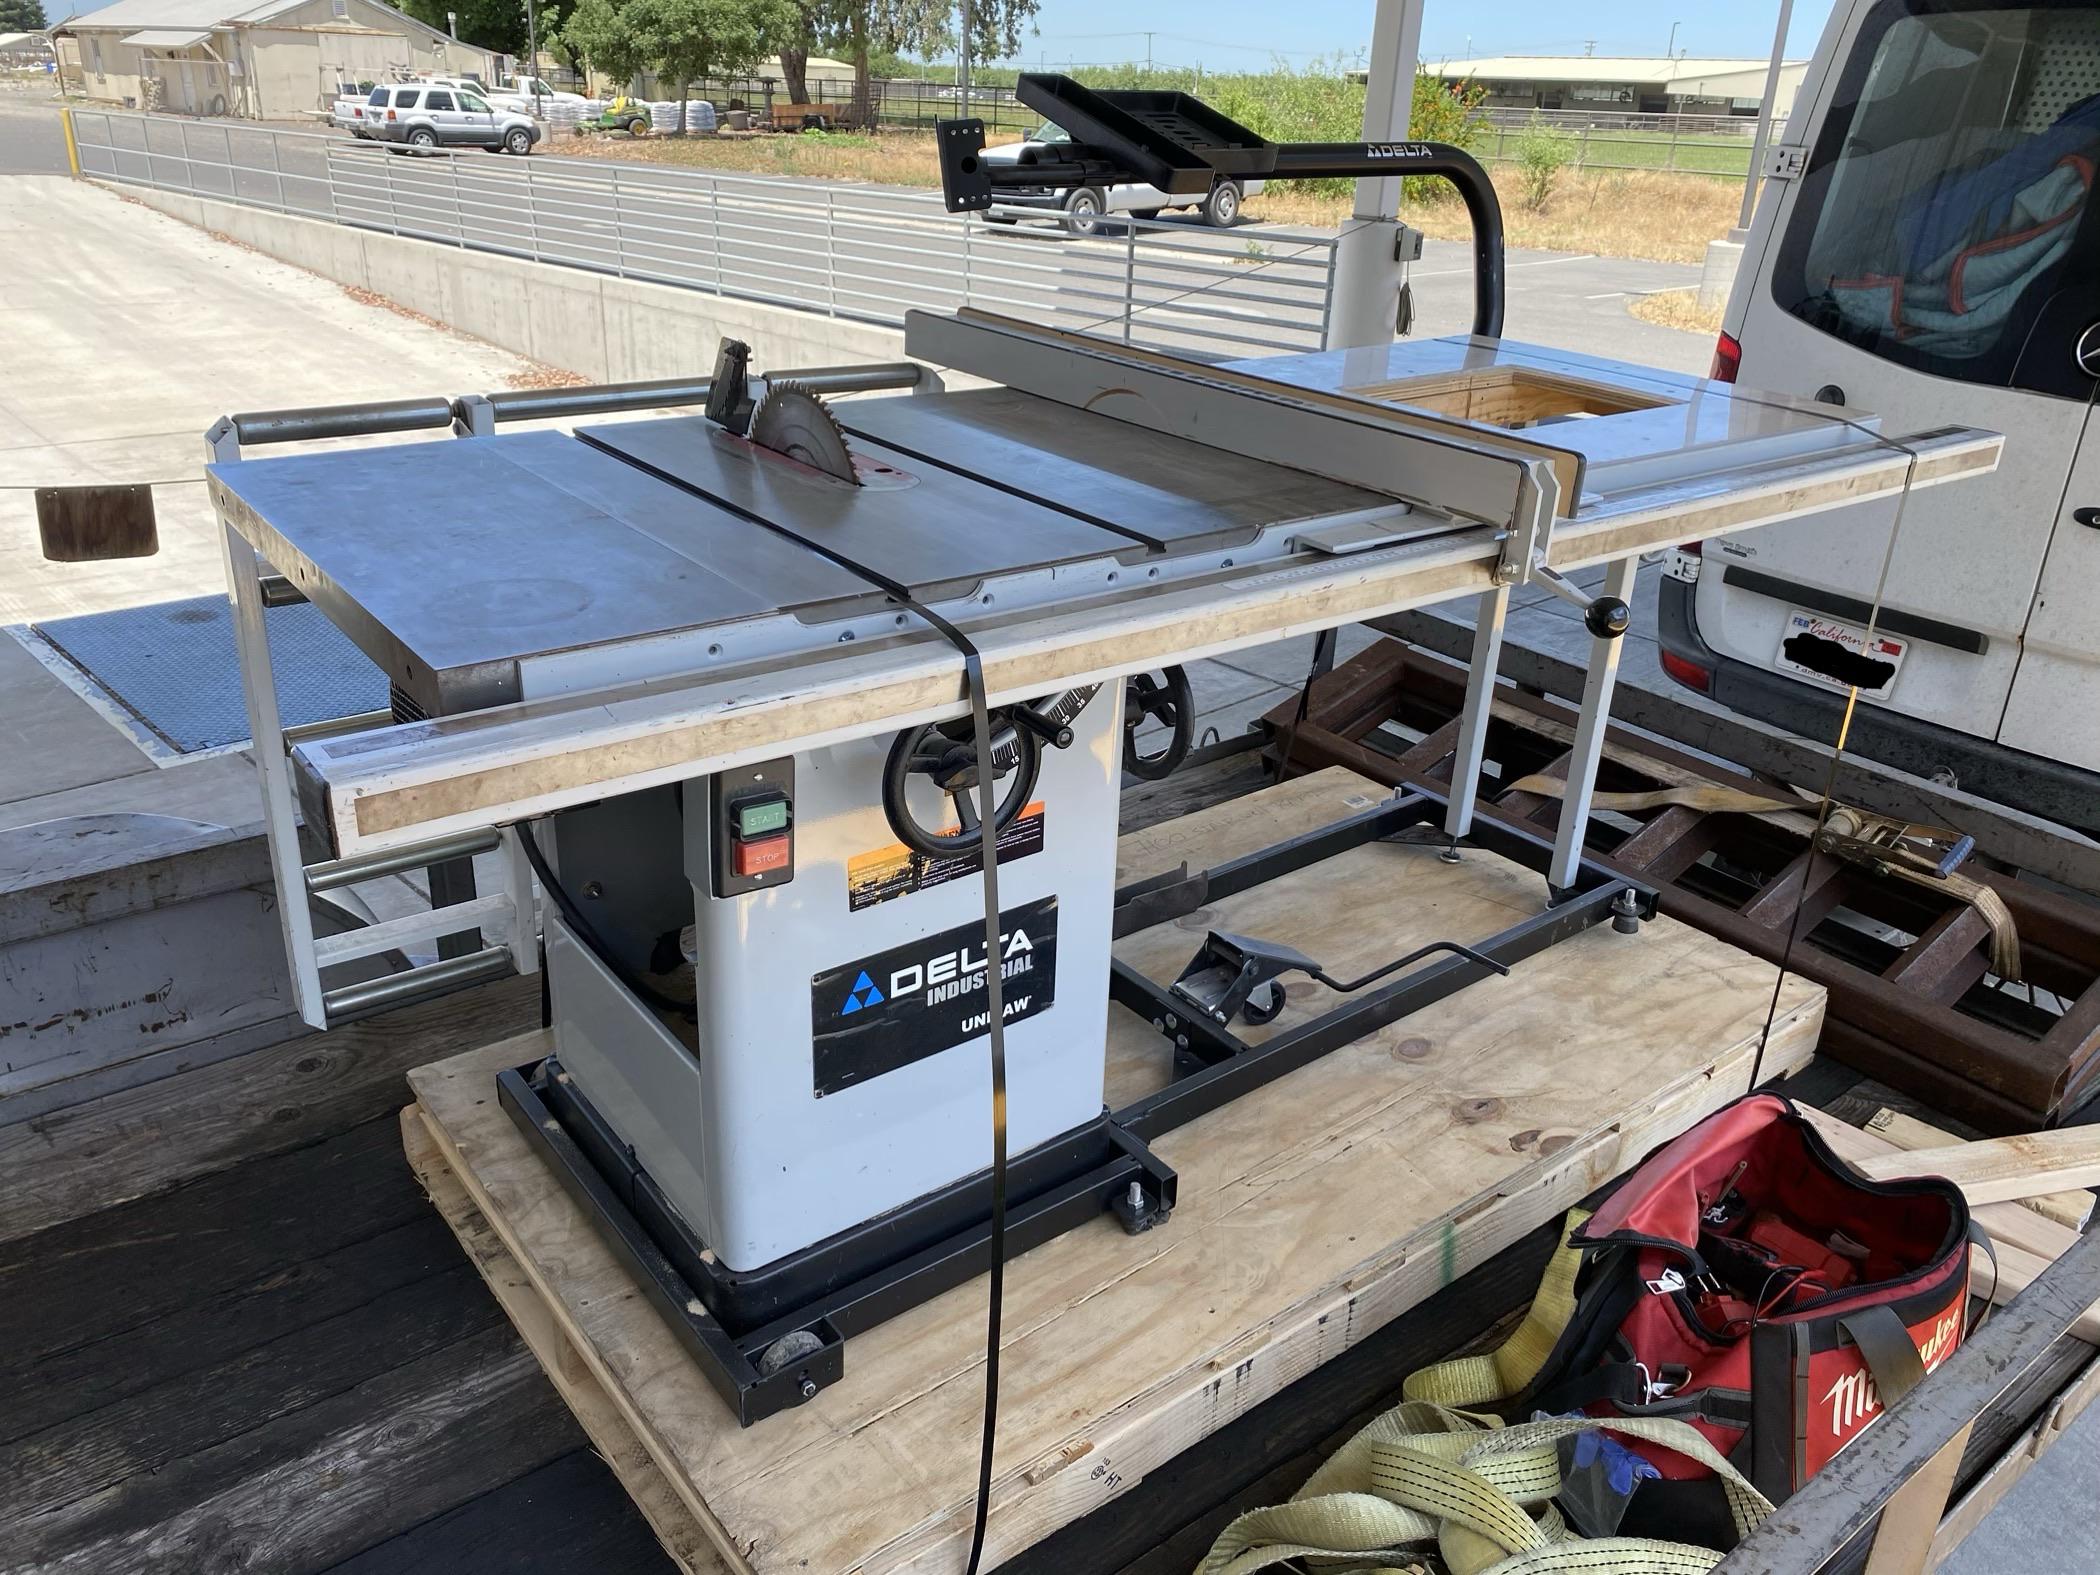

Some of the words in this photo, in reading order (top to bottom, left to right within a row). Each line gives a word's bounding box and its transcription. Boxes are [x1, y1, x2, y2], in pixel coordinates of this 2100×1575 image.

[1380, 144, 1432, 157] DELTA
[1792, 617, 1809, 628] FEB
[1810, 621, 1881, 653] Californa
[1076, 699, 1086, 709] 35
[1061, 715, 1070, 725] 30
[1011, 755, 1020, 765] 15
[755, 852, 779, 865] STOP
[927, 954, 1034, 1007] INDUSRIAL
[961, 995, 1030, 1033] UNIAW
[1103, 1471, 1122, 1490] HT
